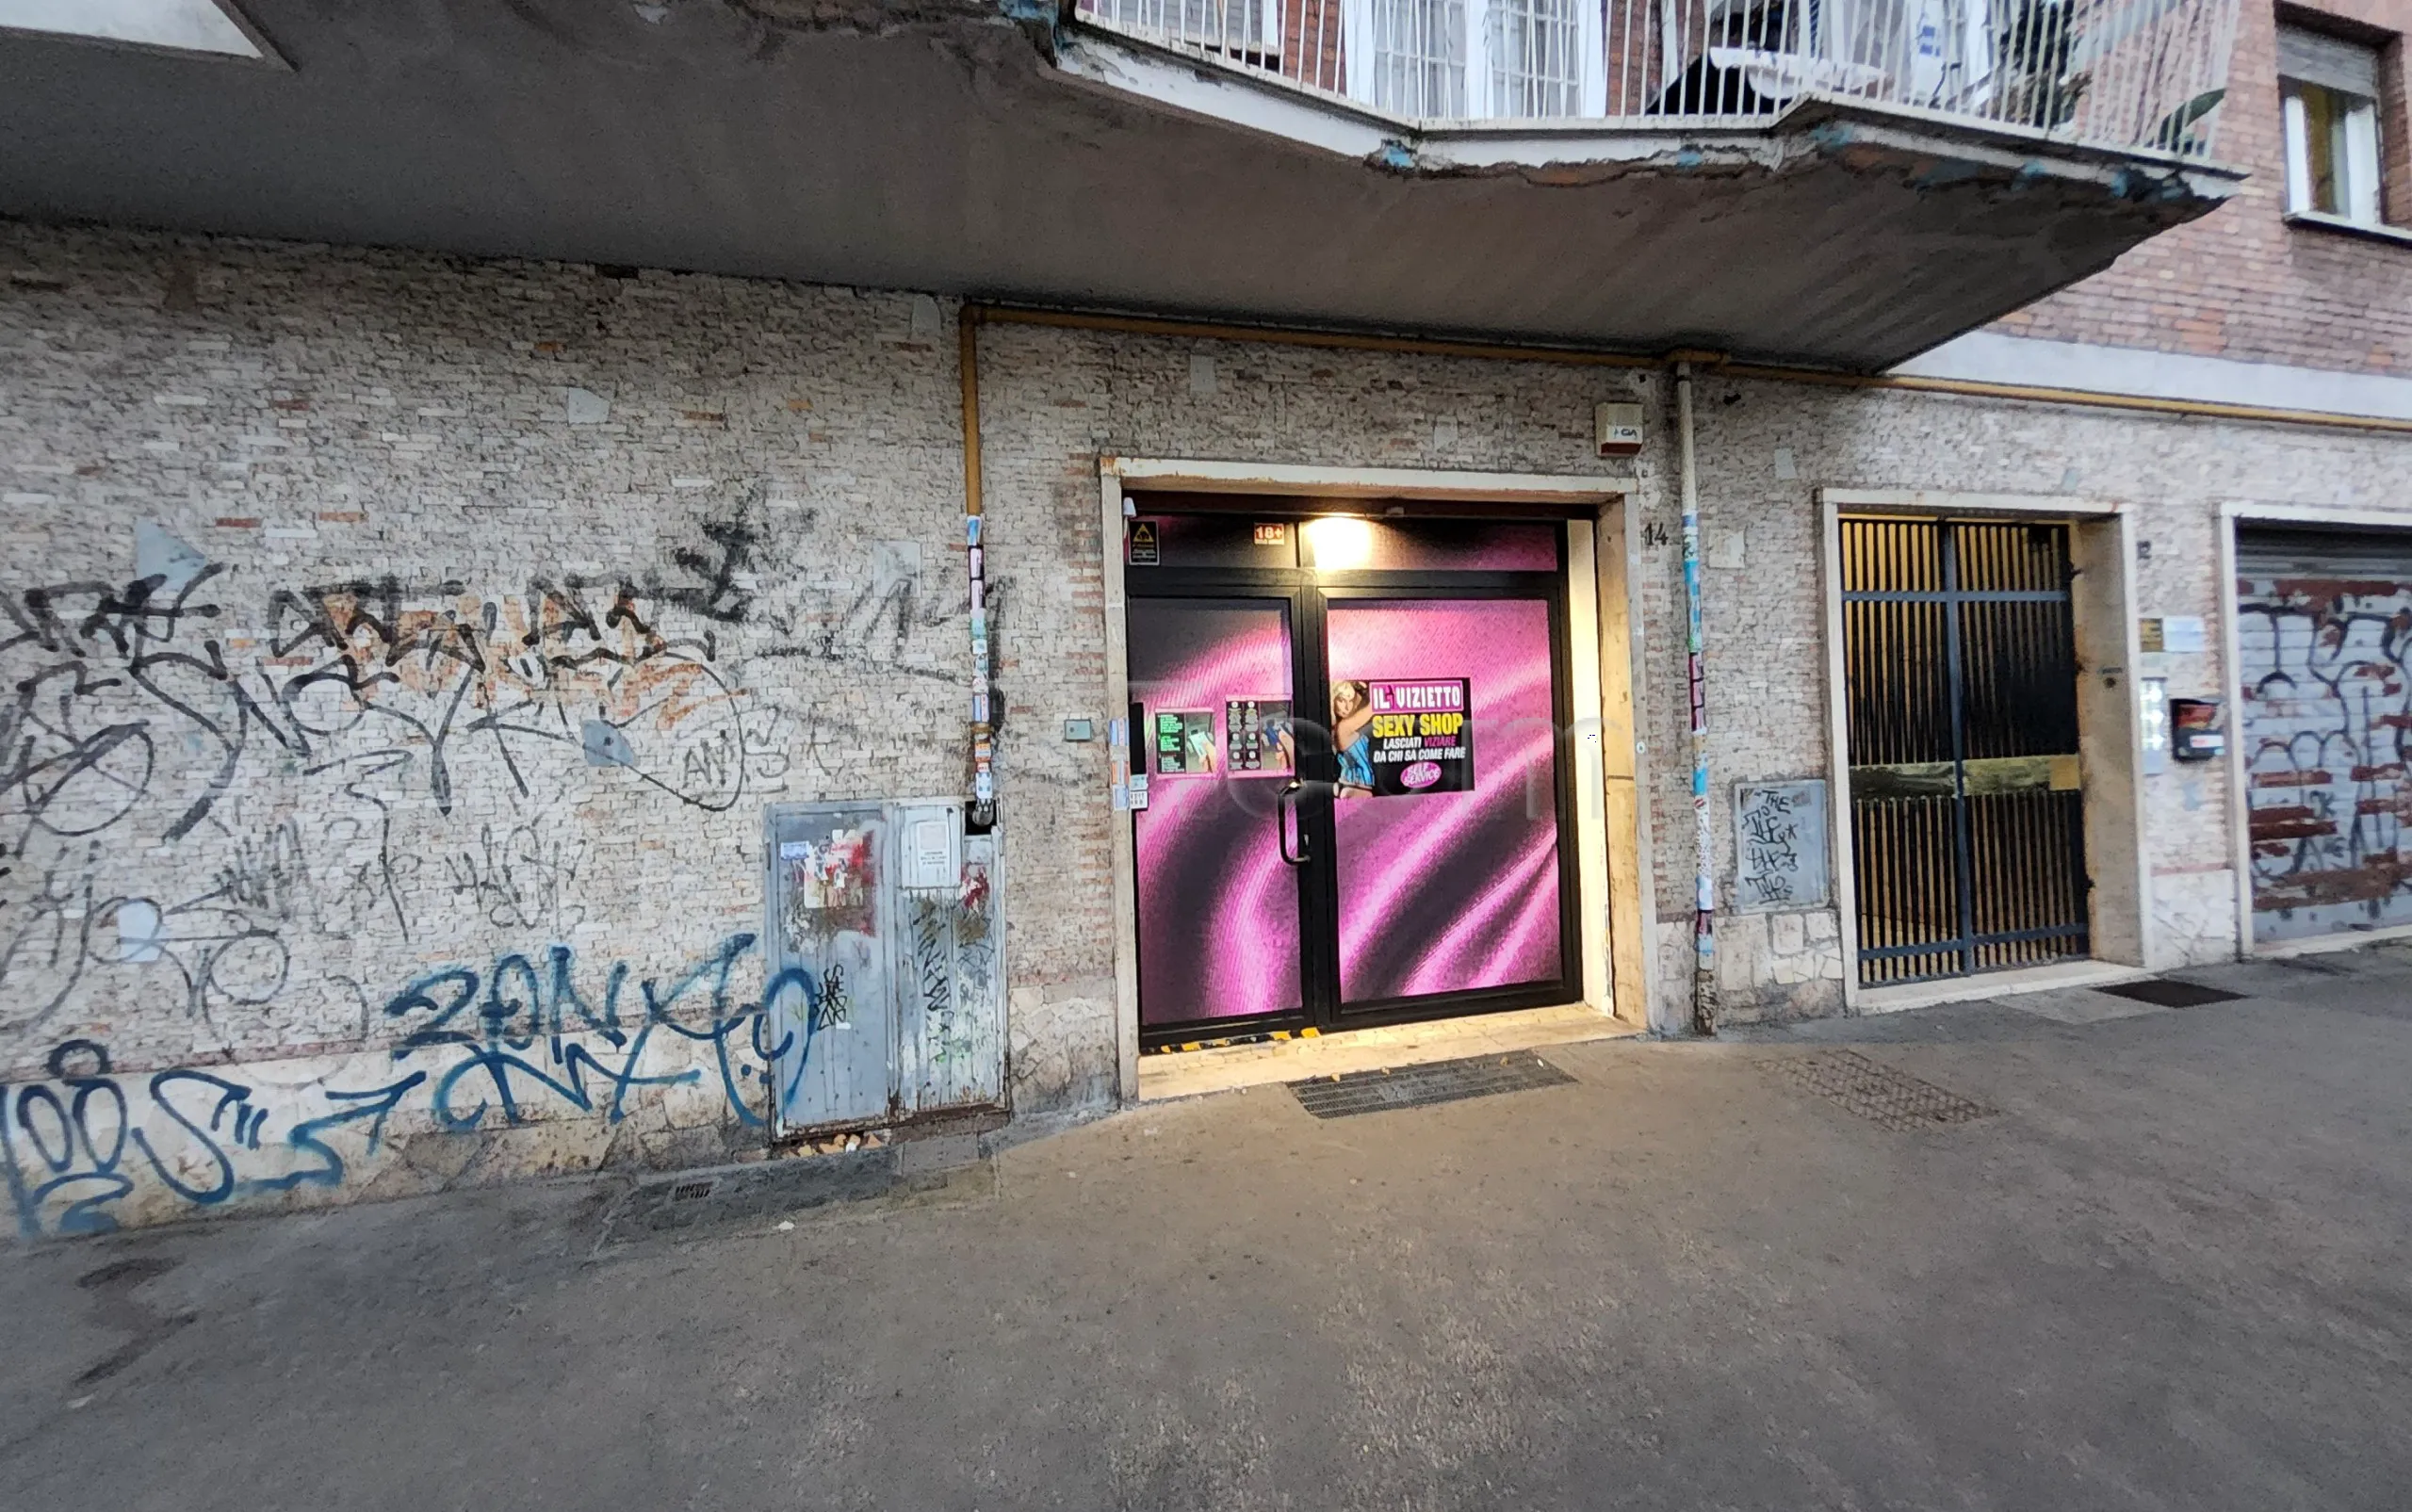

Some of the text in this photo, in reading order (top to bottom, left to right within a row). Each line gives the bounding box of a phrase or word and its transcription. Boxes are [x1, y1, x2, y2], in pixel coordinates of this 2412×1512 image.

[1256, 526, 1283, 539] 18+
[1645, 521, 1669, 545] 14
[1373, 686, 1460, 709] IL VIZIETTO
[1372, 713, 1463, 738] SEXY SHOP
[1383, 736, 1456, 750] LASCIATI VIZIARE
[1373, 747, 1466, 763] DA CHI SA COME FARE
